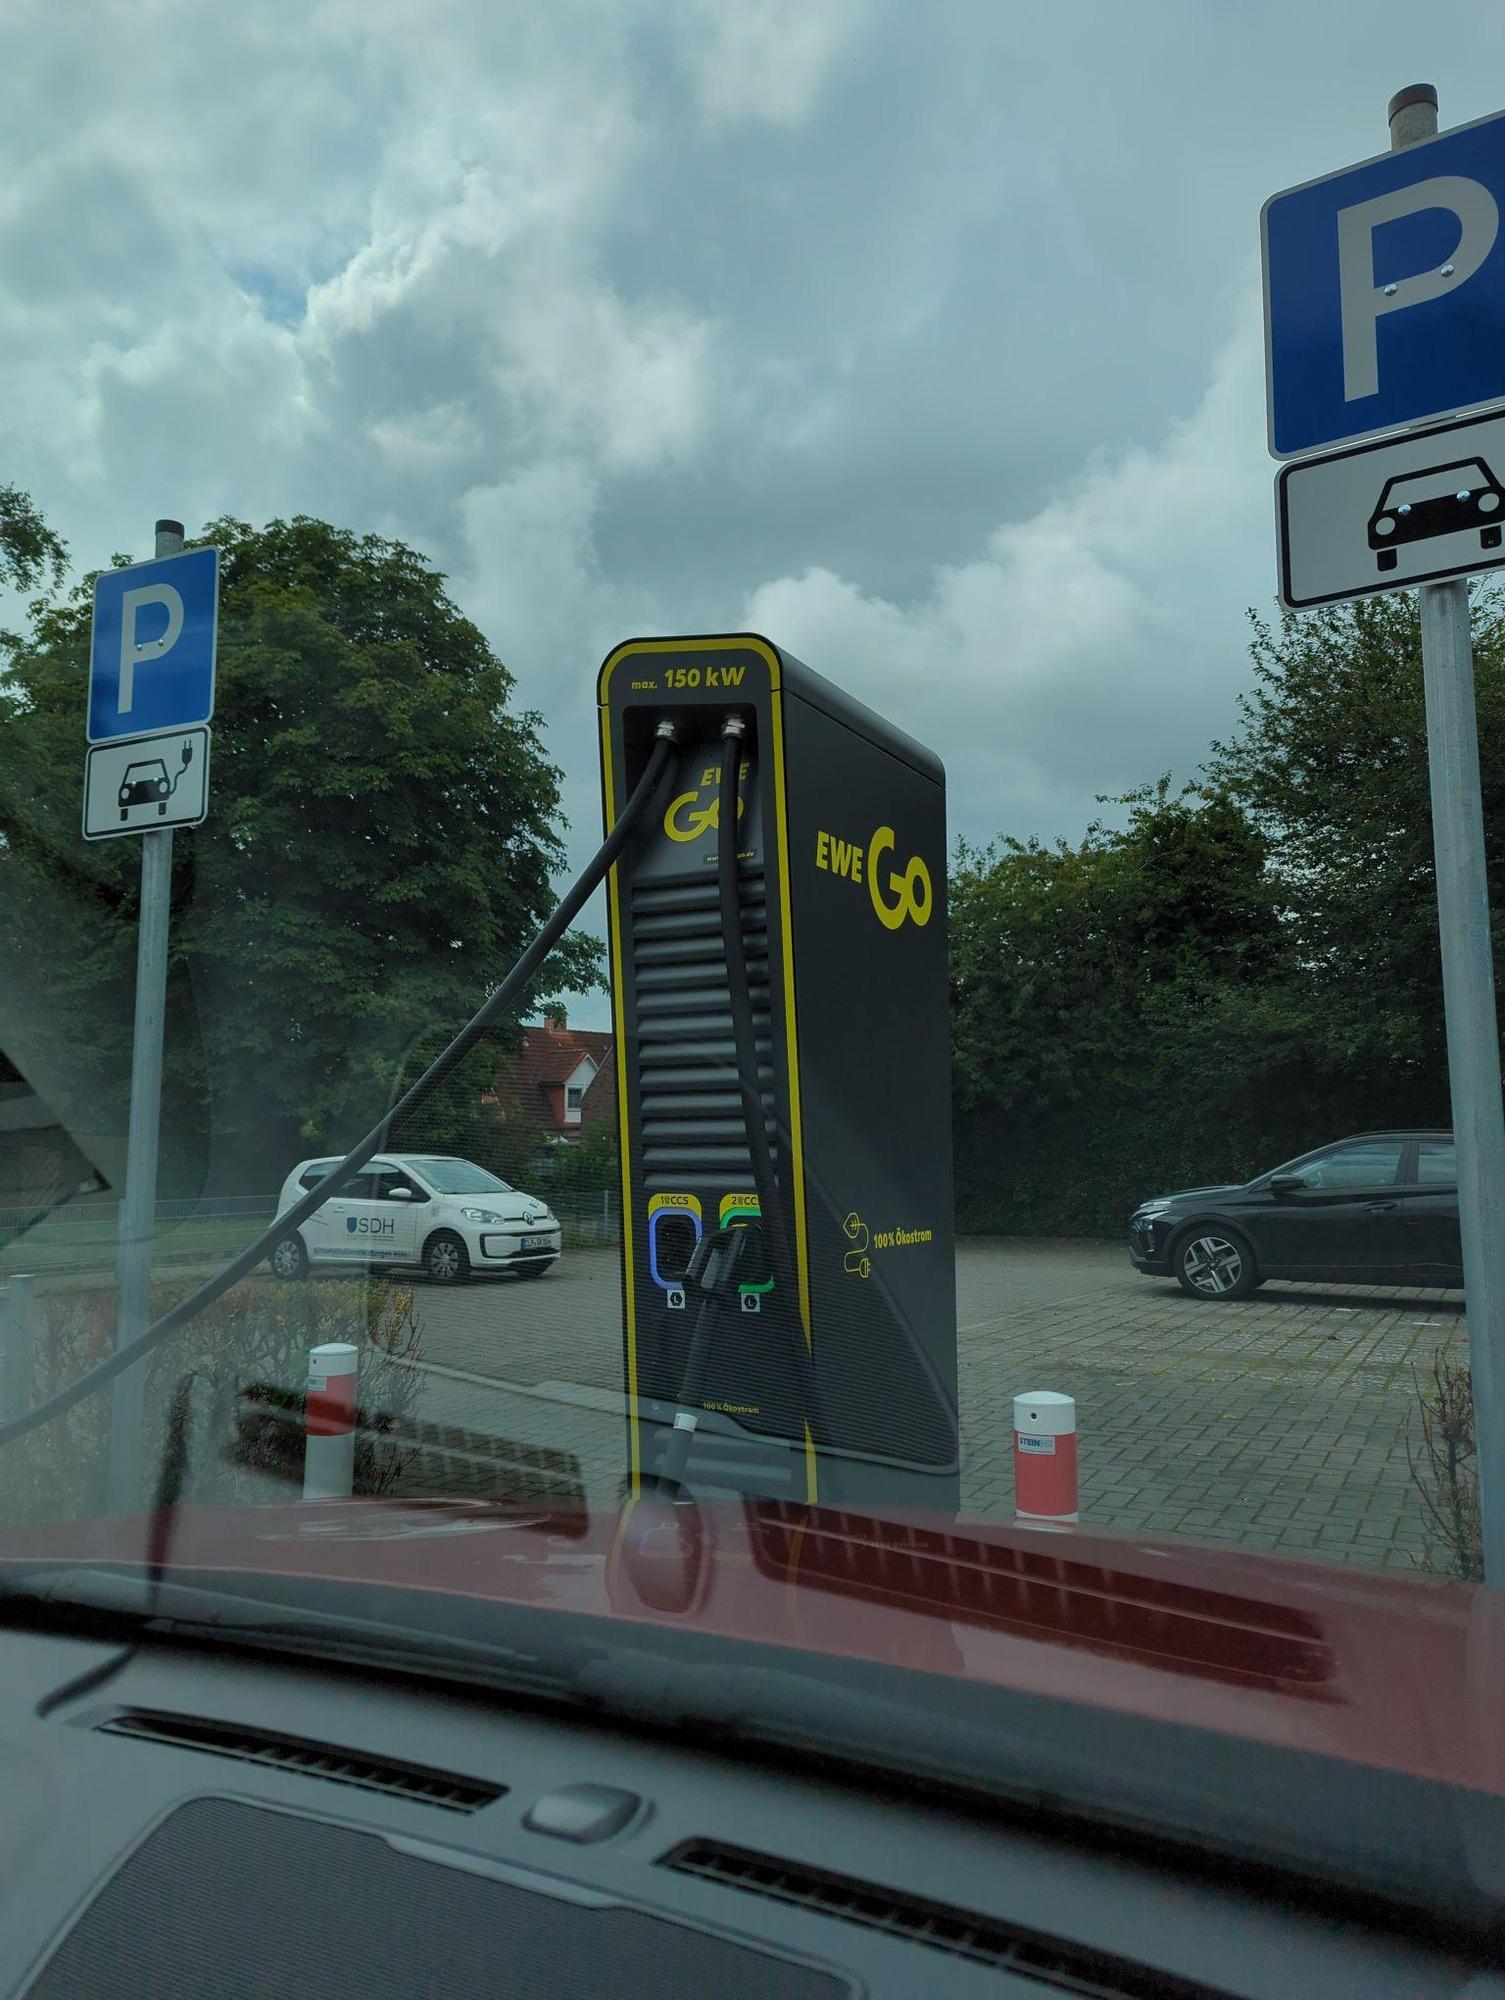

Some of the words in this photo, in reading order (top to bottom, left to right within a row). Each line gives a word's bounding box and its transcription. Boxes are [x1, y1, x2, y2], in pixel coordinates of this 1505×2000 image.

[1337, 175, 1500, 403] P
[117, 582, 185, 715] P
[631, 680, 658, 690] max.
[664, 667, 701, 689] 150
[705, 666, 746, 688] kW
[701, 762, 750, 787] EE
[816, 829, 864, 885] EWE
[744, 1196, 761, 1206] CC
[358, 1217, 395, 1235] SDH
[895, 1227, 933, 1247] Ökostrom
[722, 1402, 760, 1415] Ökostrom
